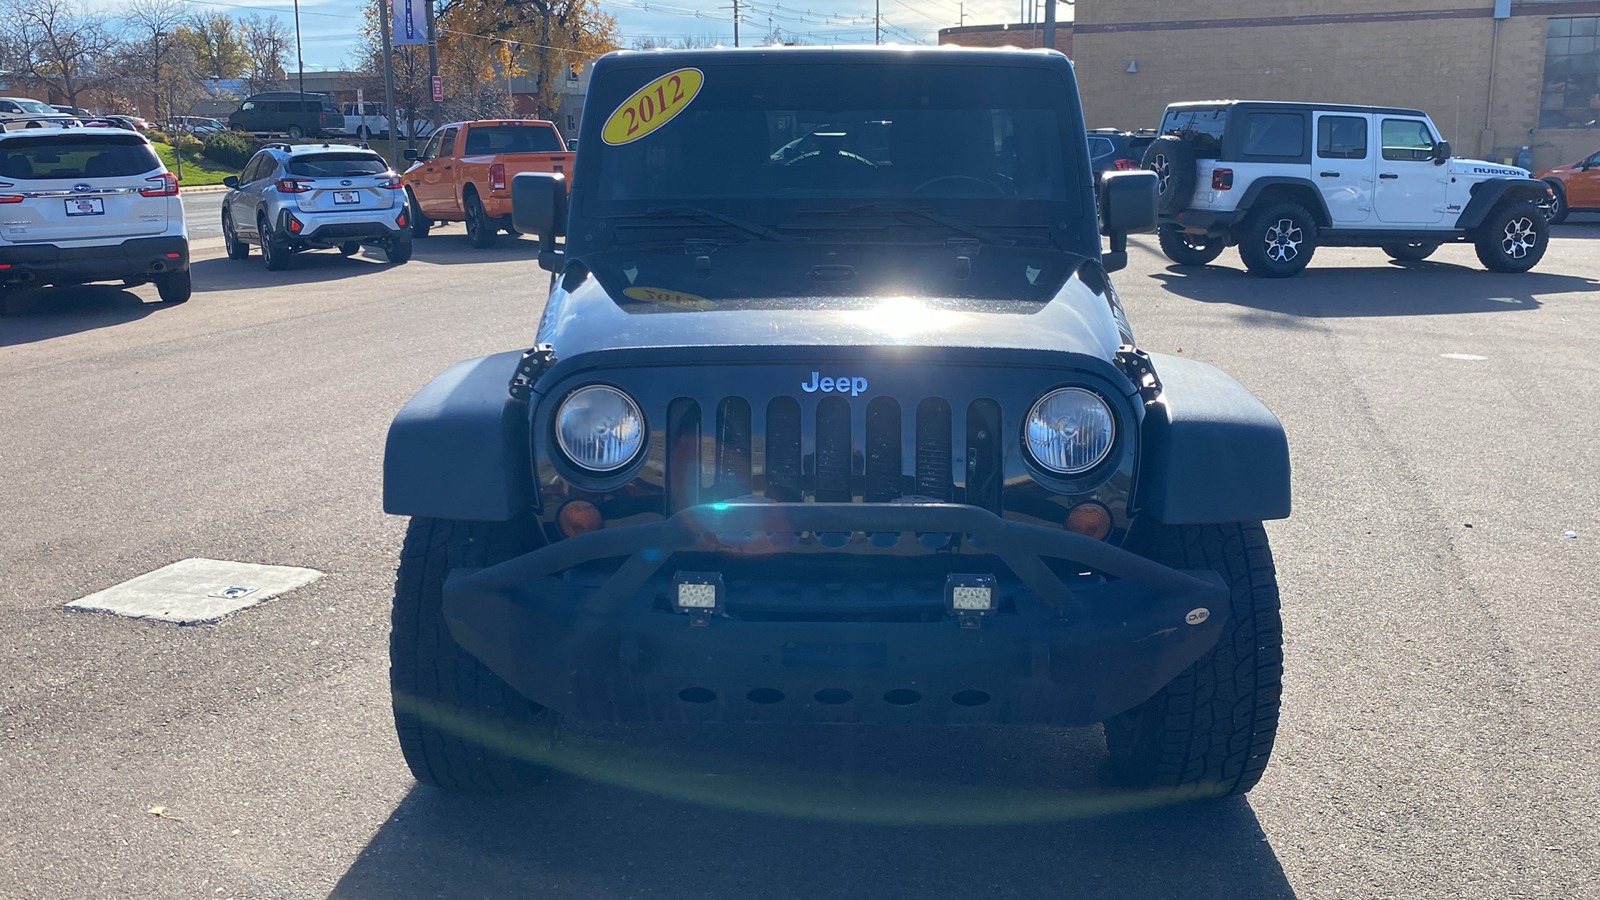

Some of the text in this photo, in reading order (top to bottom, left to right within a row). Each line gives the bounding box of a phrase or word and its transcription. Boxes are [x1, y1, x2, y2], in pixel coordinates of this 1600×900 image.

[622, 75, 685, 137] 2012
[1473, 167, 1525, 177] RUBICON
[801, 371, 868, 397] Jeep
